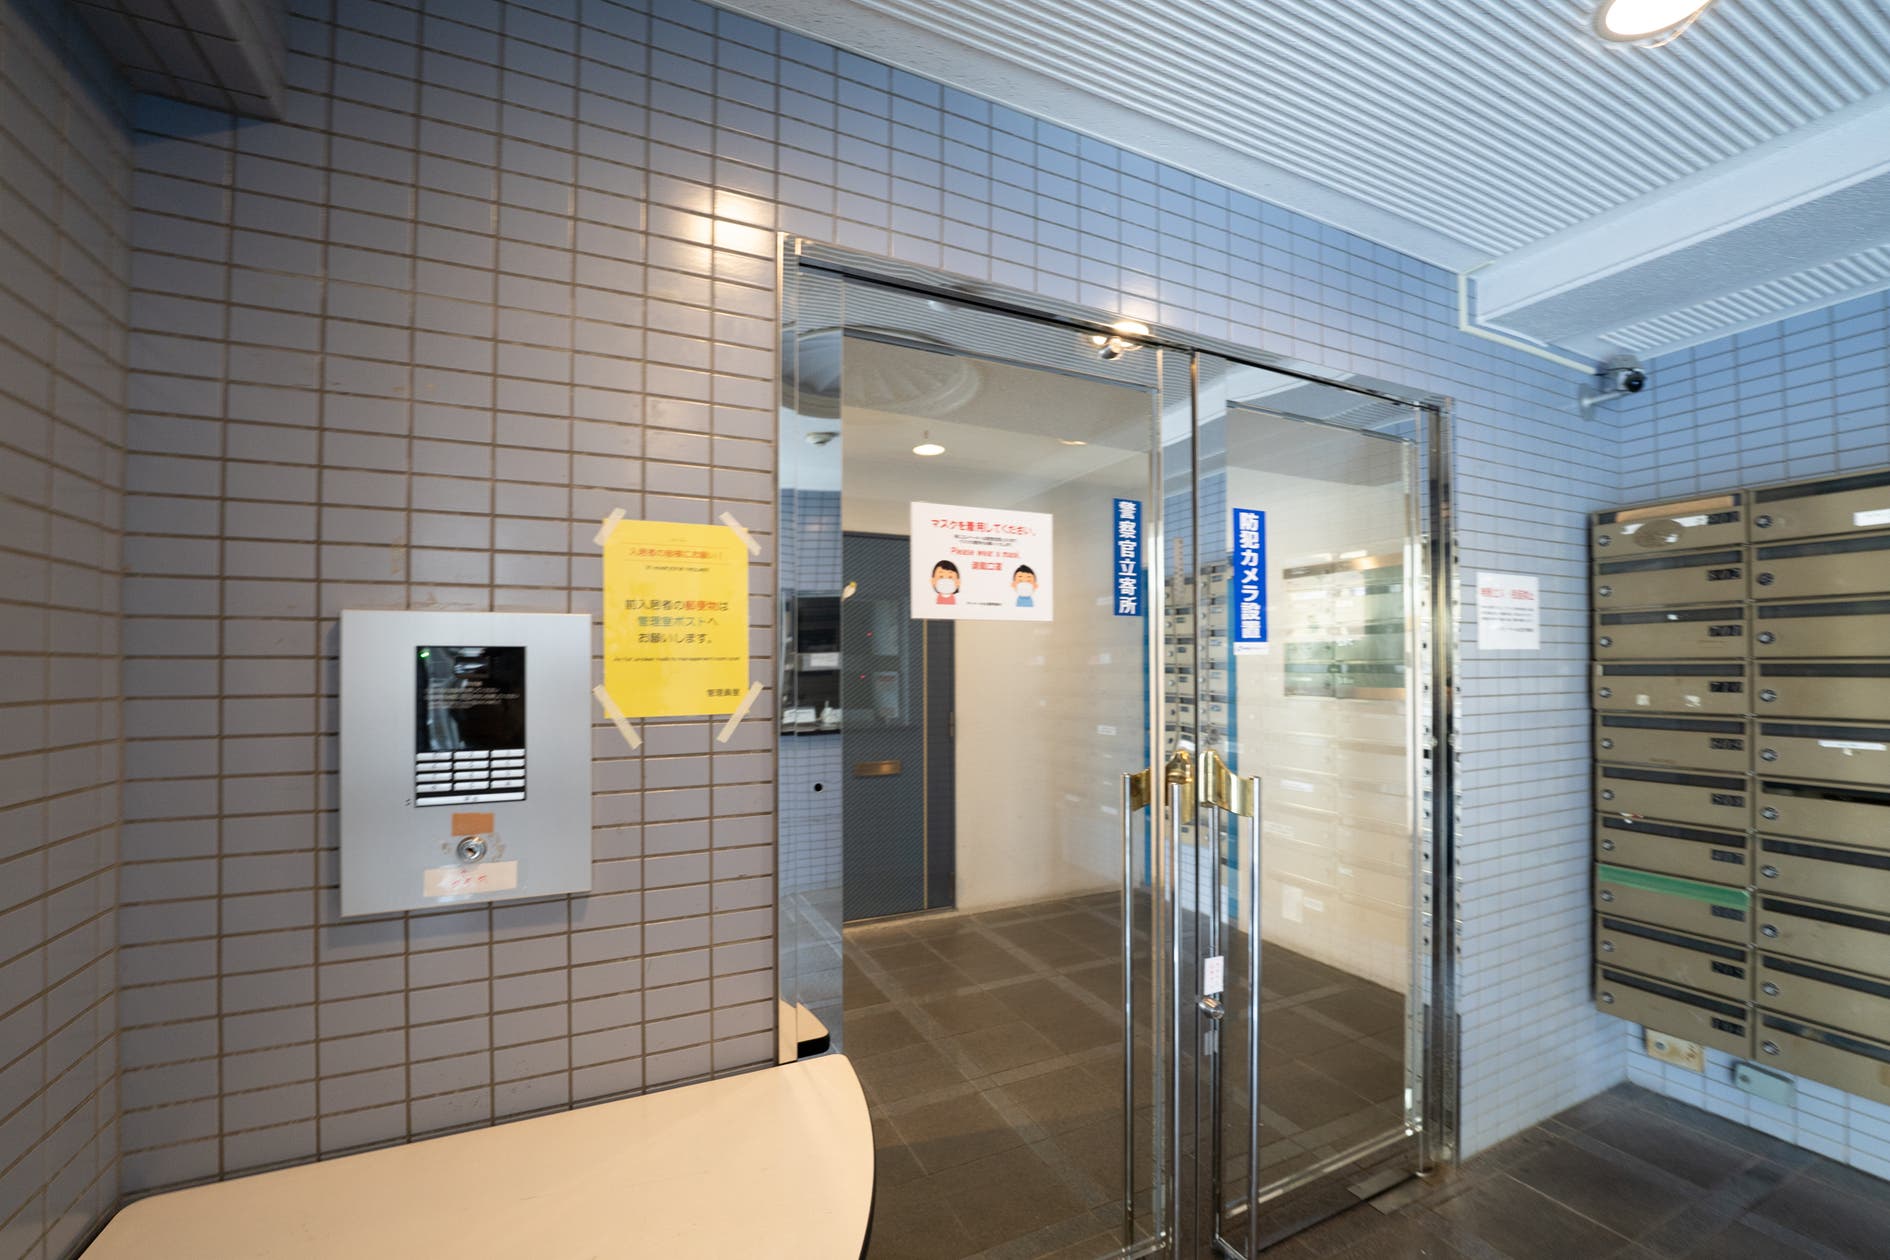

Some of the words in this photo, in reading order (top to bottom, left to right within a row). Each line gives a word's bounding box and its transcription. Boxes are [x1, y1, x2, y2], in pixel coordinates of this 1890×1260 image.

[1117, 501, 1137, 615] 警察官立寄所
[1239, 511, 1262, 639] 防犯カメラ設置
